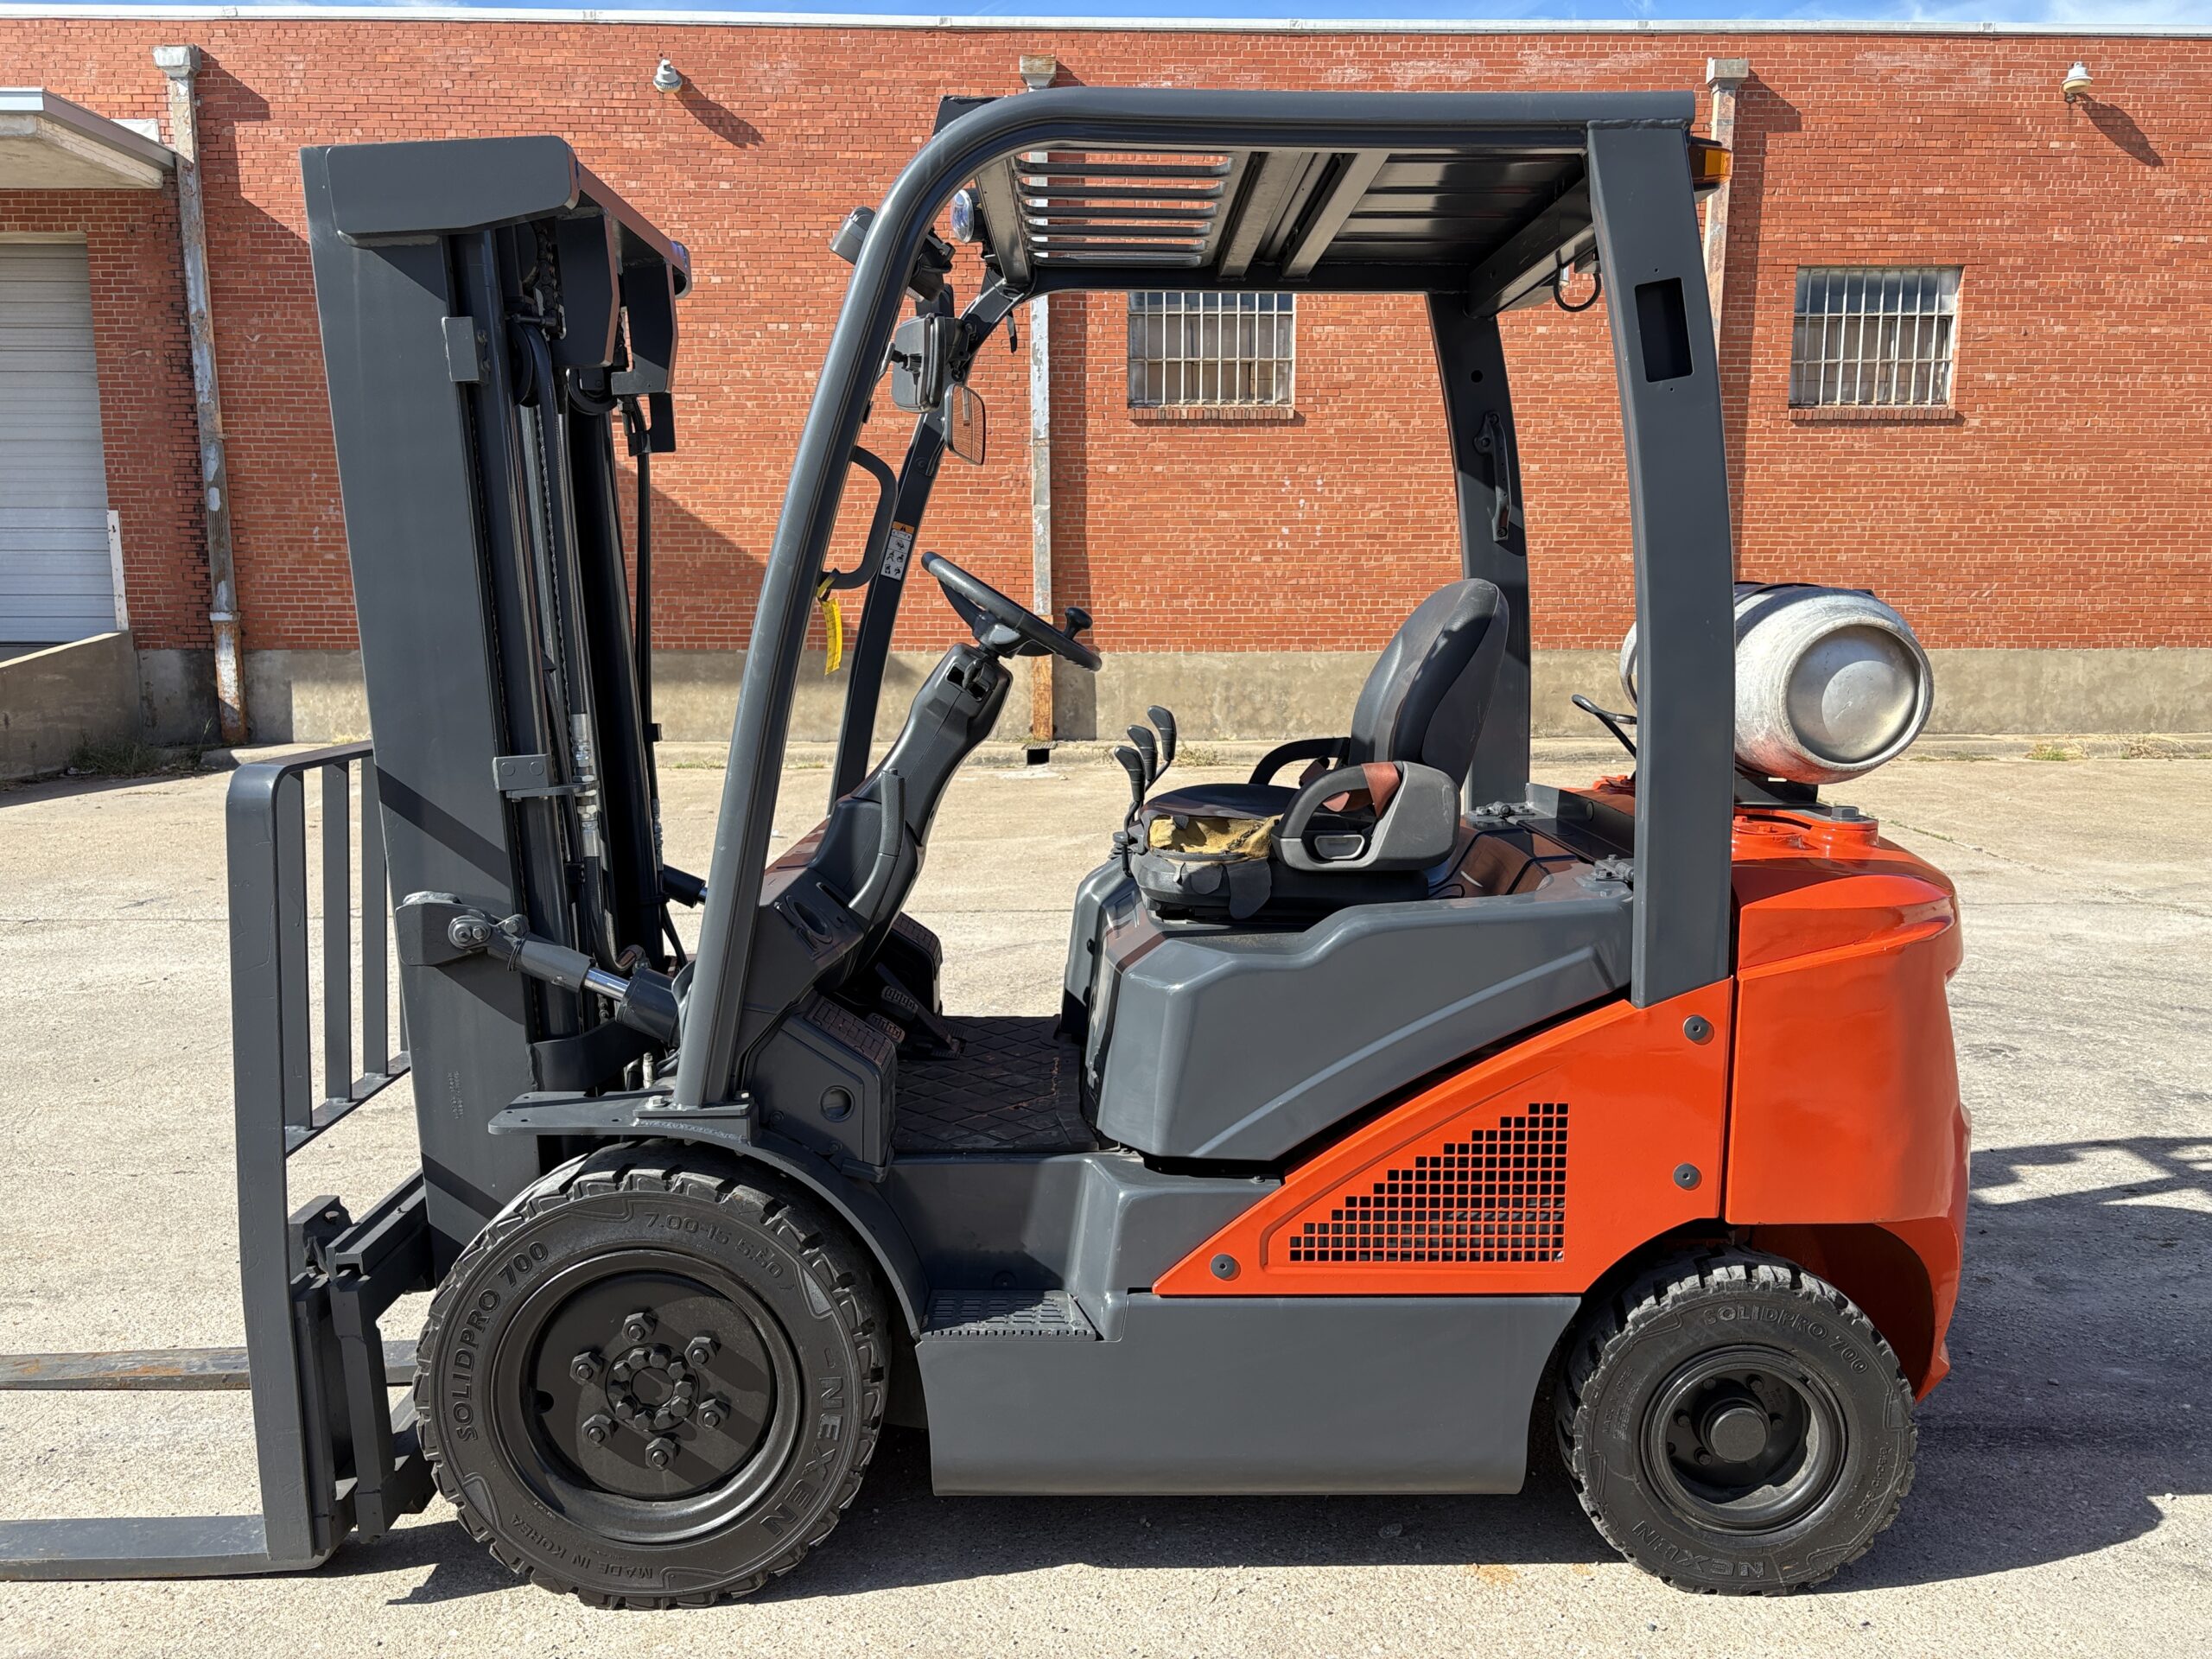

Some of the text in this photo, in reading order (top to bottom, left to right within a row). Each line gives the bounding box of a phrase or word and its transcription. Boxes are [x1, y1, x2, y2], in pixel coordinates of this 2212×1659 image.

[451, 1241, 549, 1441] SOLIDPRO 700
[1702, 1305, 1868, 1374] SOLIDPRO 700
[760, 1376, 844, 1536] NEXEN
[511, 1513, 653, 1580] MADE IN KOREA
[1631, 1520, 1765, 1578] NEXEN
